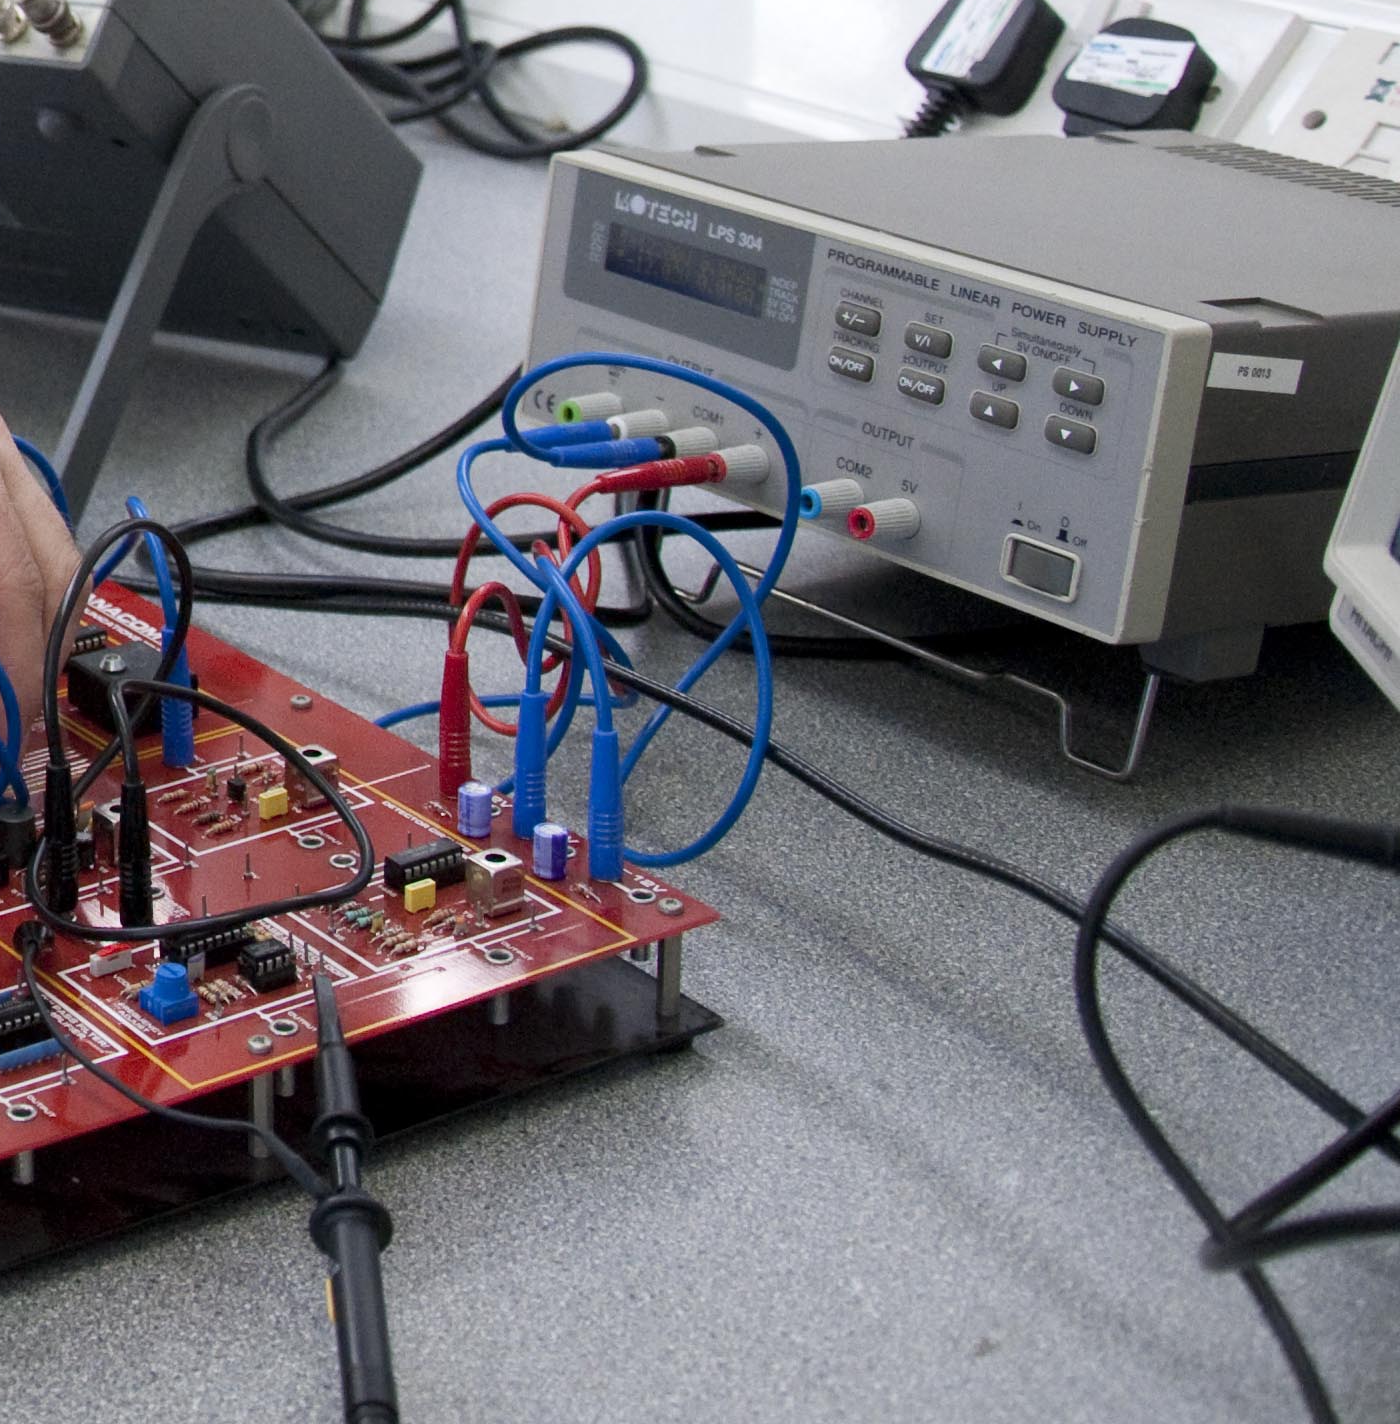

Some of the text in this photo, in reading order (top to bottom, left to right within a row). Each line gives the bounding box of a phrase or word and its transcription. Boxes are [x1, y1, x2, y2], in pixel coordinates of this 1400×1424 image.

[708, 222, 735, 244] LPS
[738, 232, 763, 252] 304
[827, 248, 1138, 348] PROGRAMMABLE LINEAR POWER SUPPLY
[840, 287, 885, 309] CHANNEL
[925, 312, 944, 325] SET
[832, 331, 880, 353] TRACKING
[1011, 327, 1082, 357] Simultaneously
[1017, 343, 1071, 364] 5V ON/OFF
[829, 356, 865, 373] ON/OFF
[992, 382, 1006, 392] UP
[692, 405, 724, 425] COM1
[1059, 402, 1092, 421] DOWN
[862, 422, 915, 448] OUTPUT
[836, 457, 872, 478] COM2
[901, 480, 919, 493] 5V
